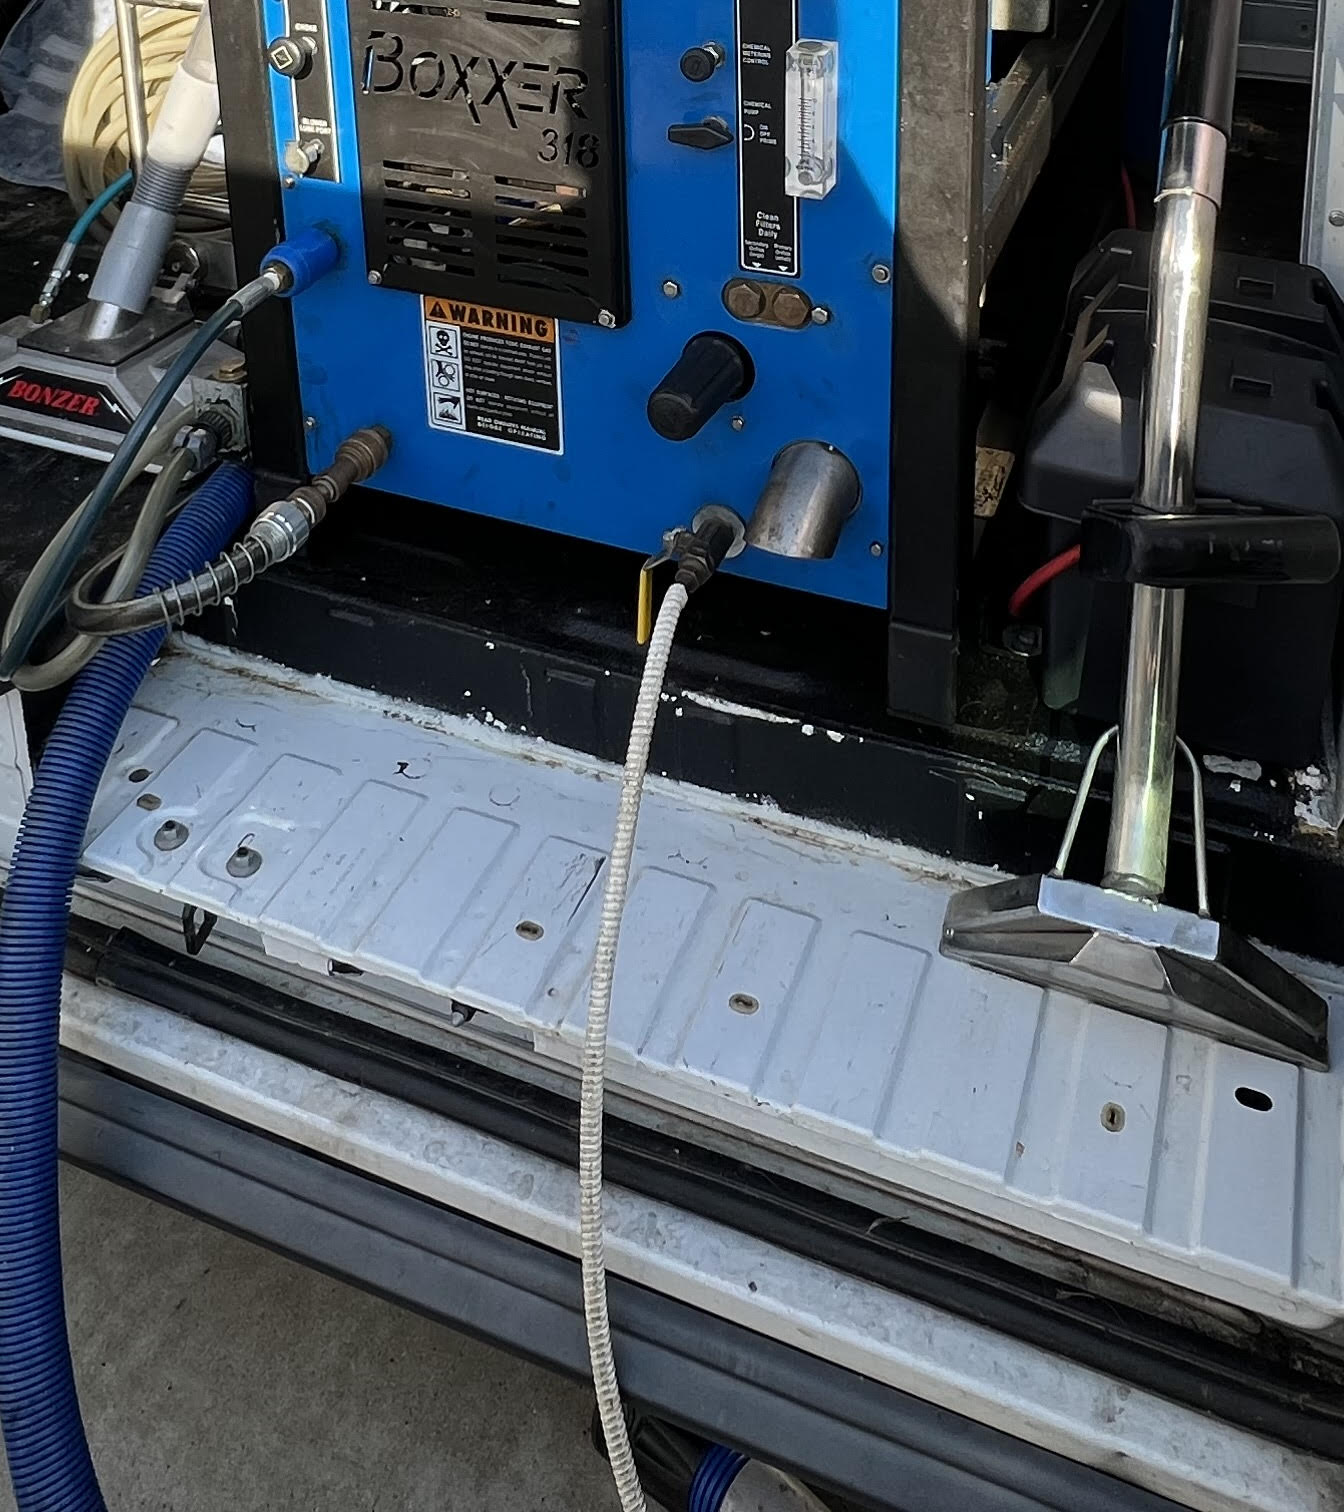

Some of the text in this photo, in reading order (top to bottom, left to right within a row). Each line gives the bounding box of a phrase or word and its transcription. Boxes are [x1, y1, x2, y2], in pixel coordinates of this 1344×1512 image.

[362, 30, 590, 129] BOXXER
[537, 129, 600, 168] 318
[756, 211, 779, 221] Clean
[758, 228, 778, 239] Daily
[448, 303, 548, 337] WARNING
[8, 380, 101, 415] BONZER
